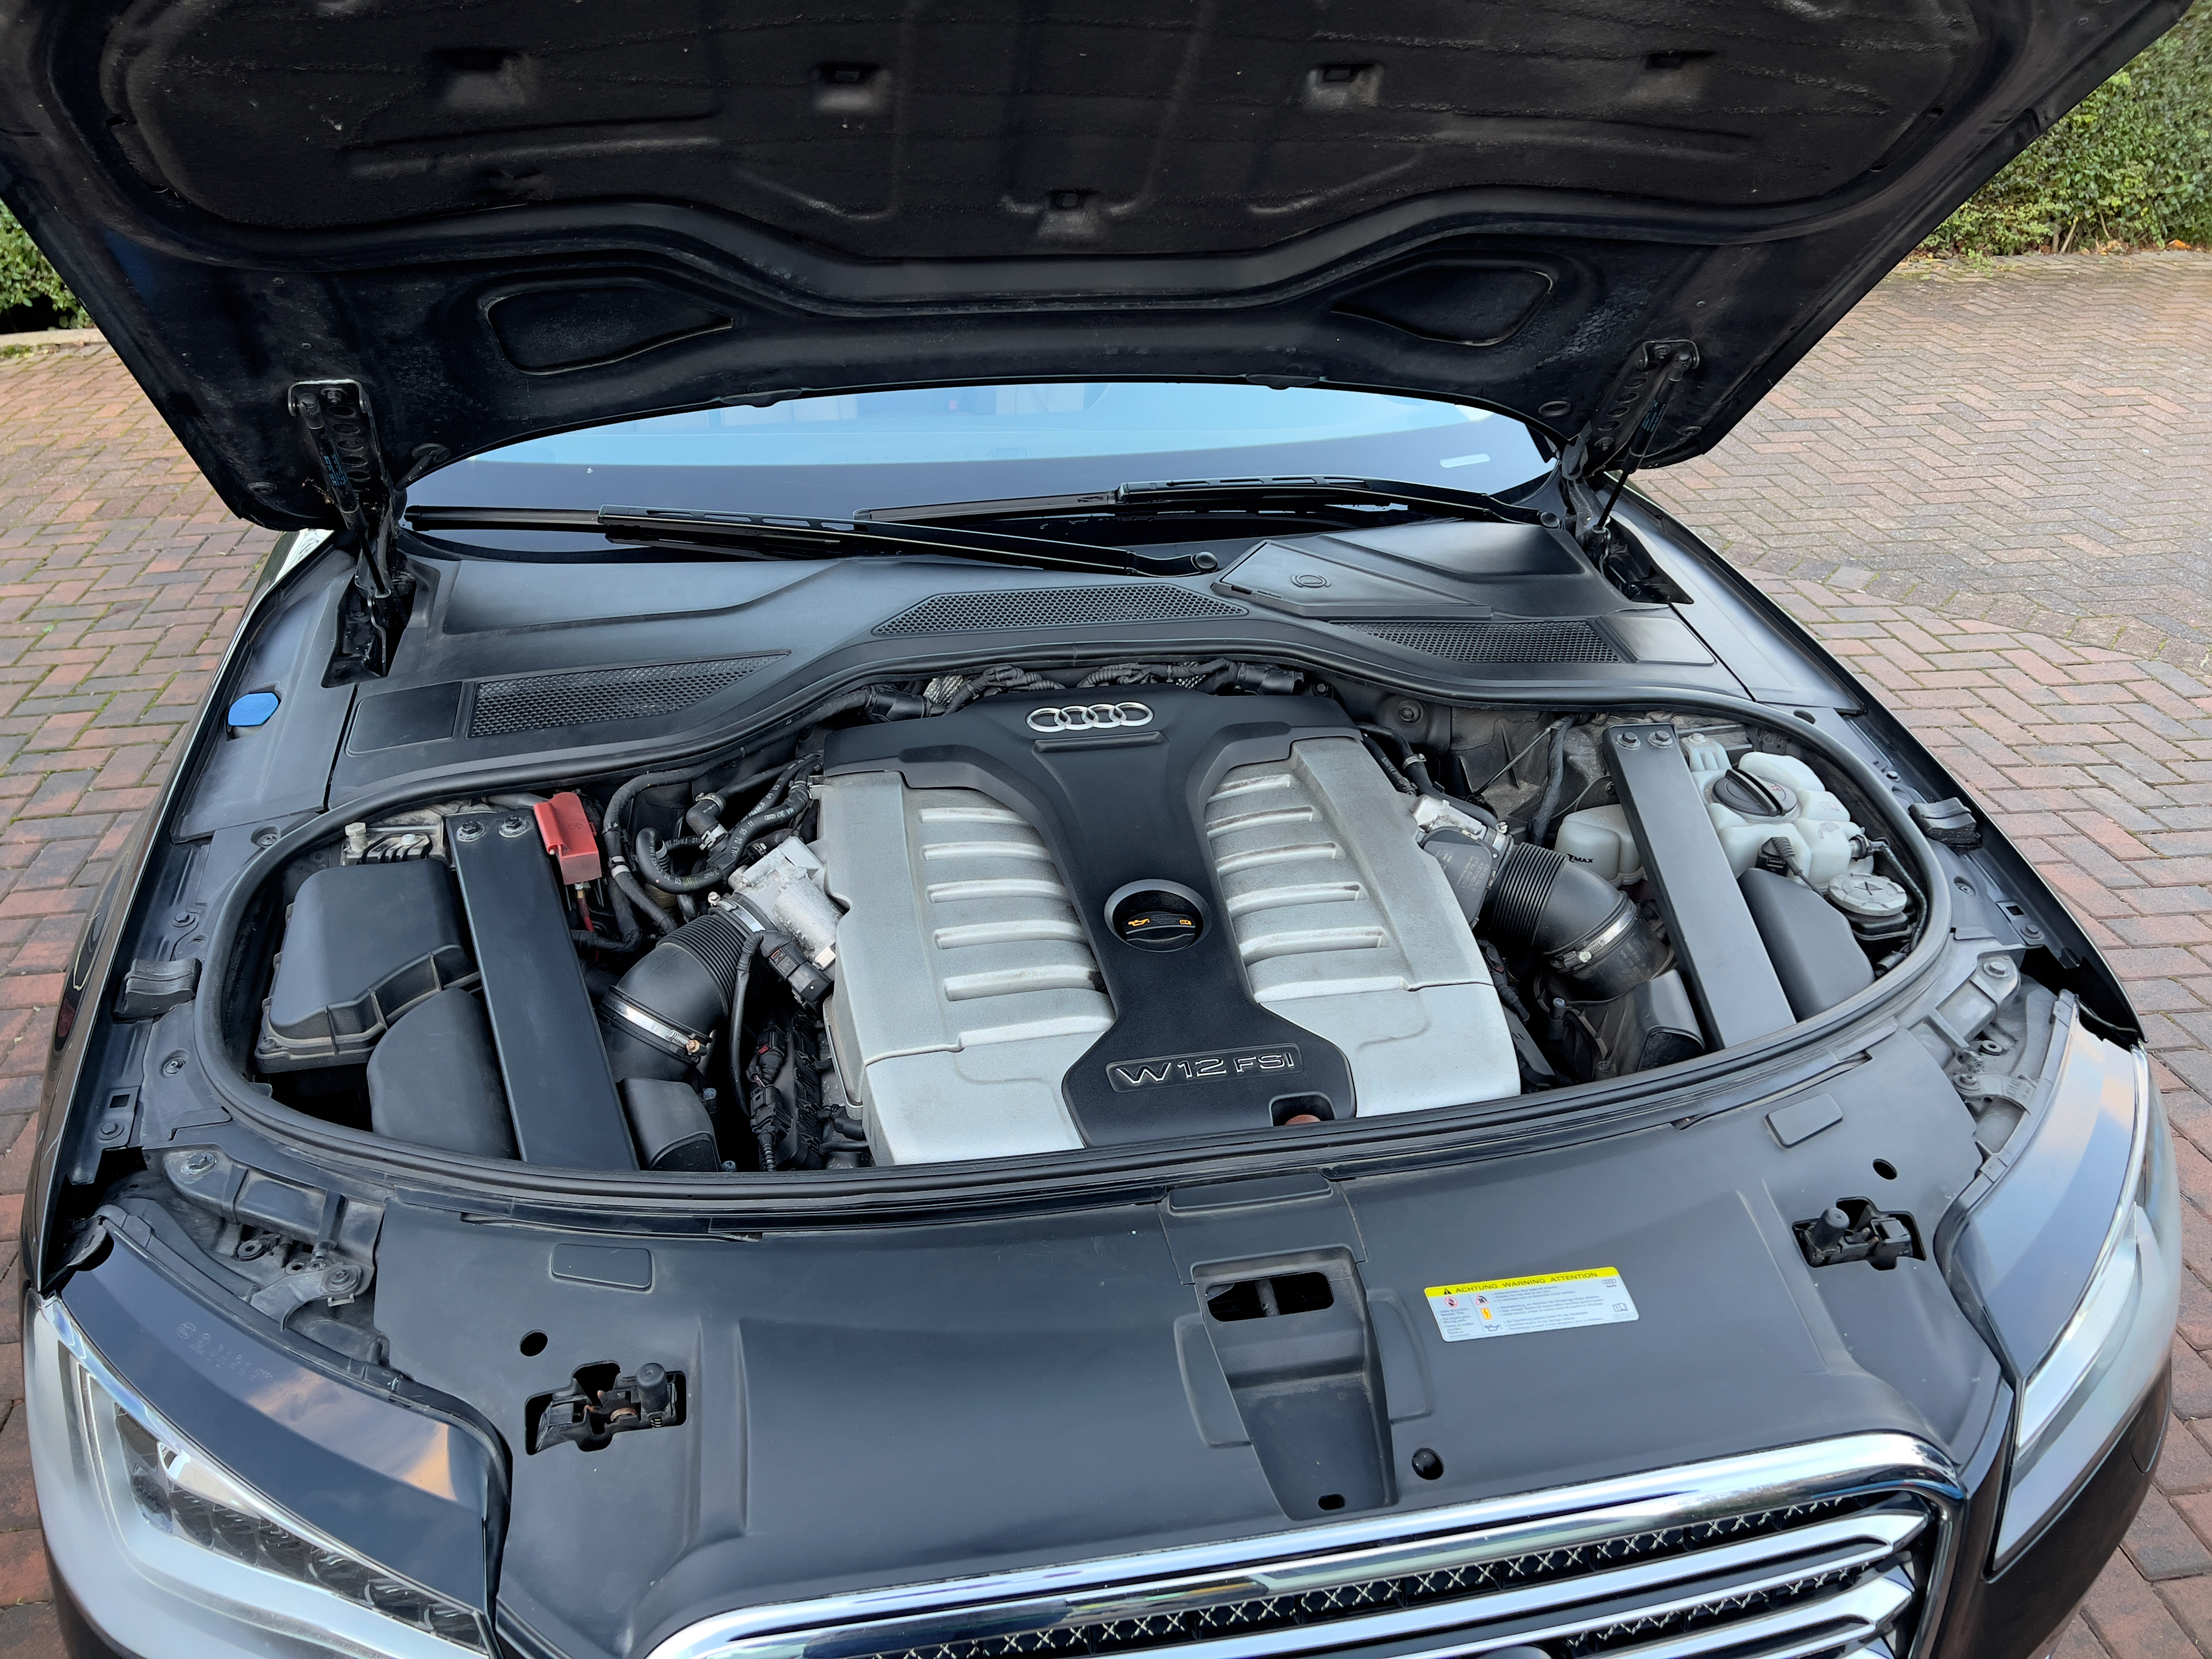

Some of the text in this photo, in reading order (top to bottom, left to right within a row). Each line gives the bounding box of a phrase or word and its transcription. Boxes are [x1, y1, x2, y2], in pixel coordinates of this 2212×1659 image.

[1233, 1053, 1294, 1073] FSI
[1455, 1283, 1498, 1293] ACHTUNG
[1502, 1278, 1546, 1288] WARNING
[1550, 1272, 1598, 1283] ATTENTION
